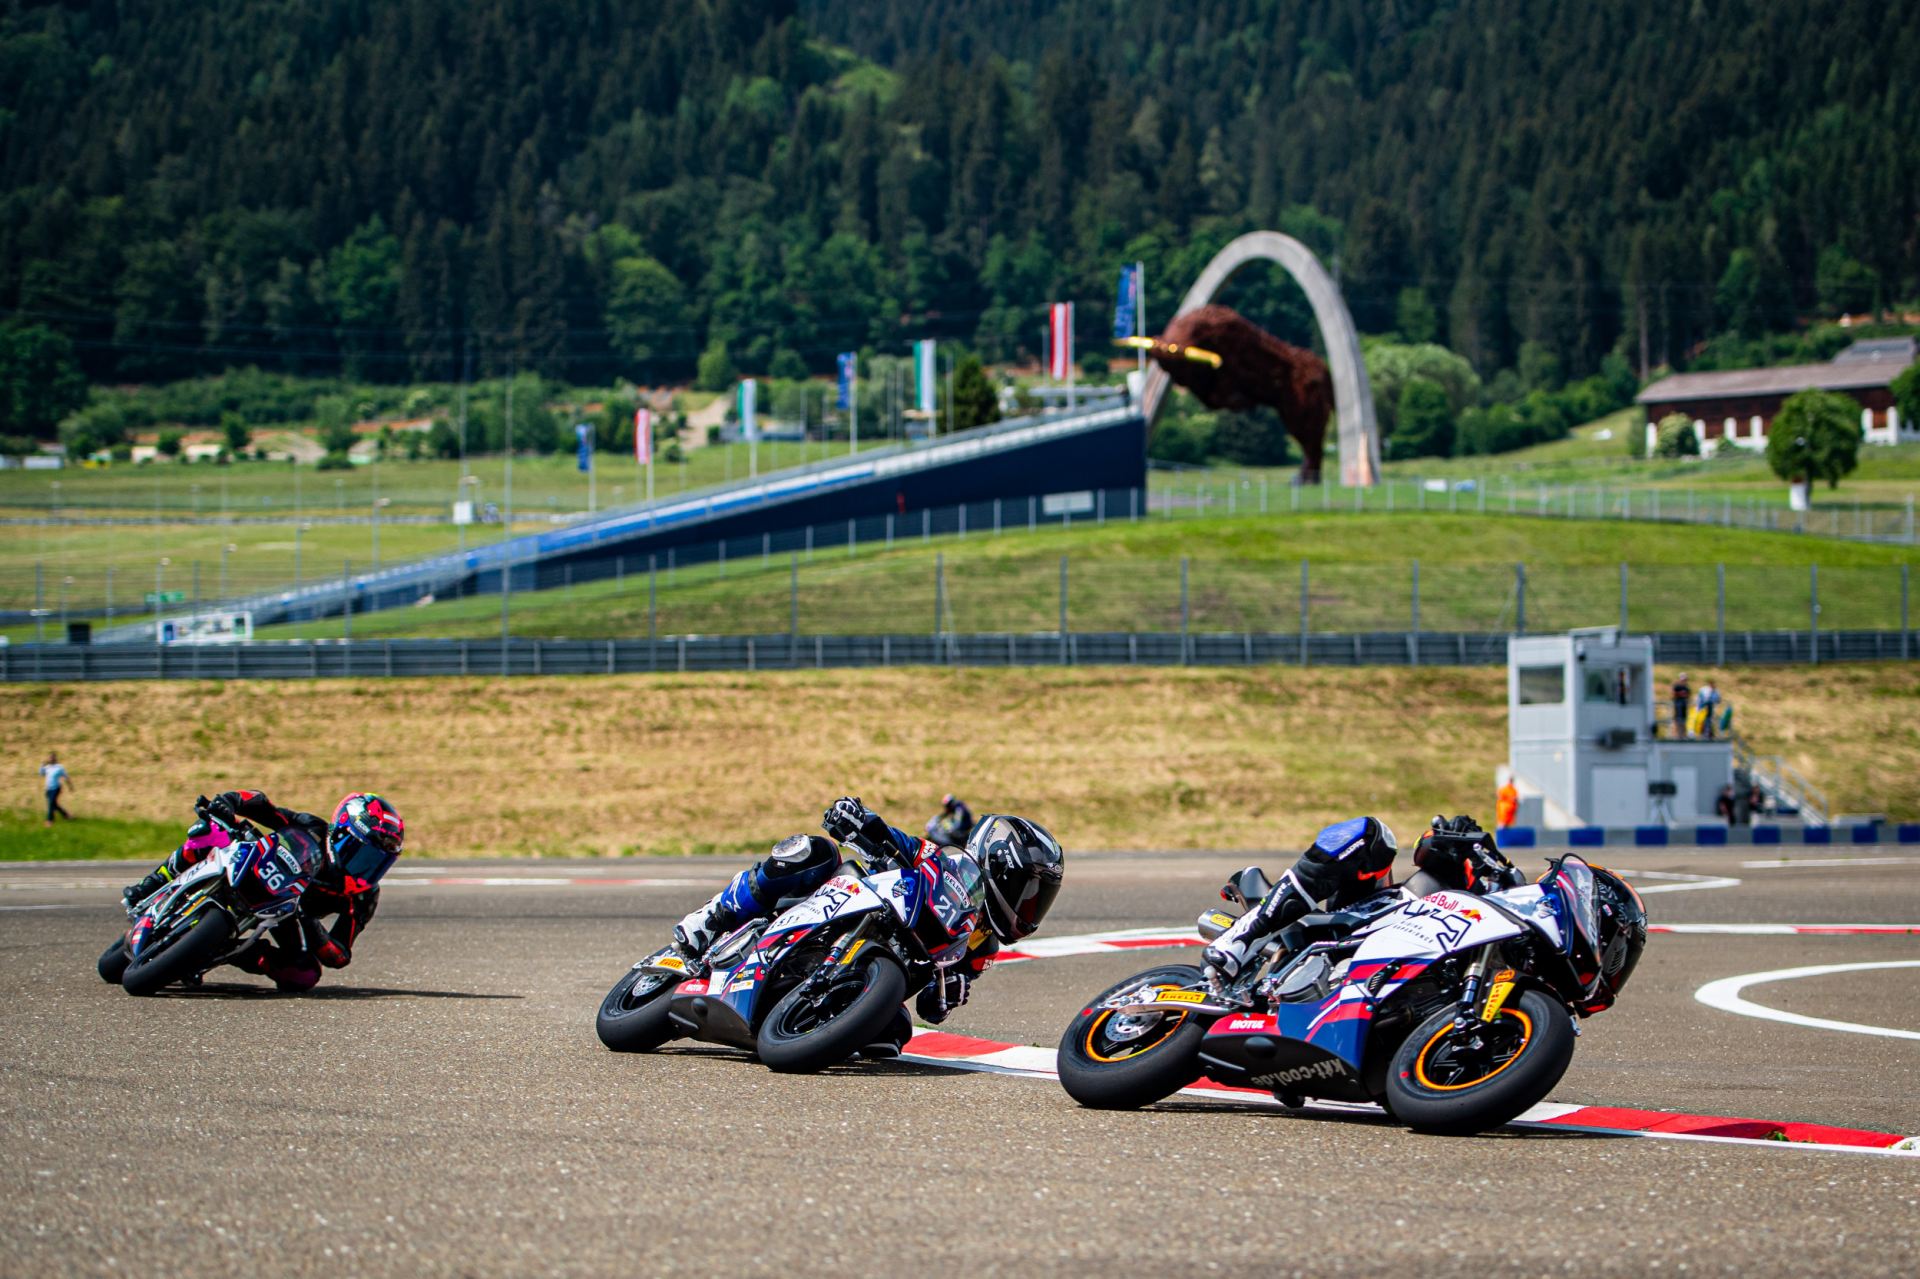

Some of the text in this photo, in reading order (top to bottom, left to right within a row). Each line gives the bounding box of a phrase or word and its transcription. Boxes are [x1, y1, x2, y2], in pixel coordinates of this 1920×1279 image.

[258, 861, 285, 891] 36
[933, 895, 957, 929] 21
[1437, 895, 1459, 911] Bull
[1229, 1019, 1265, 1029] MOTUL
